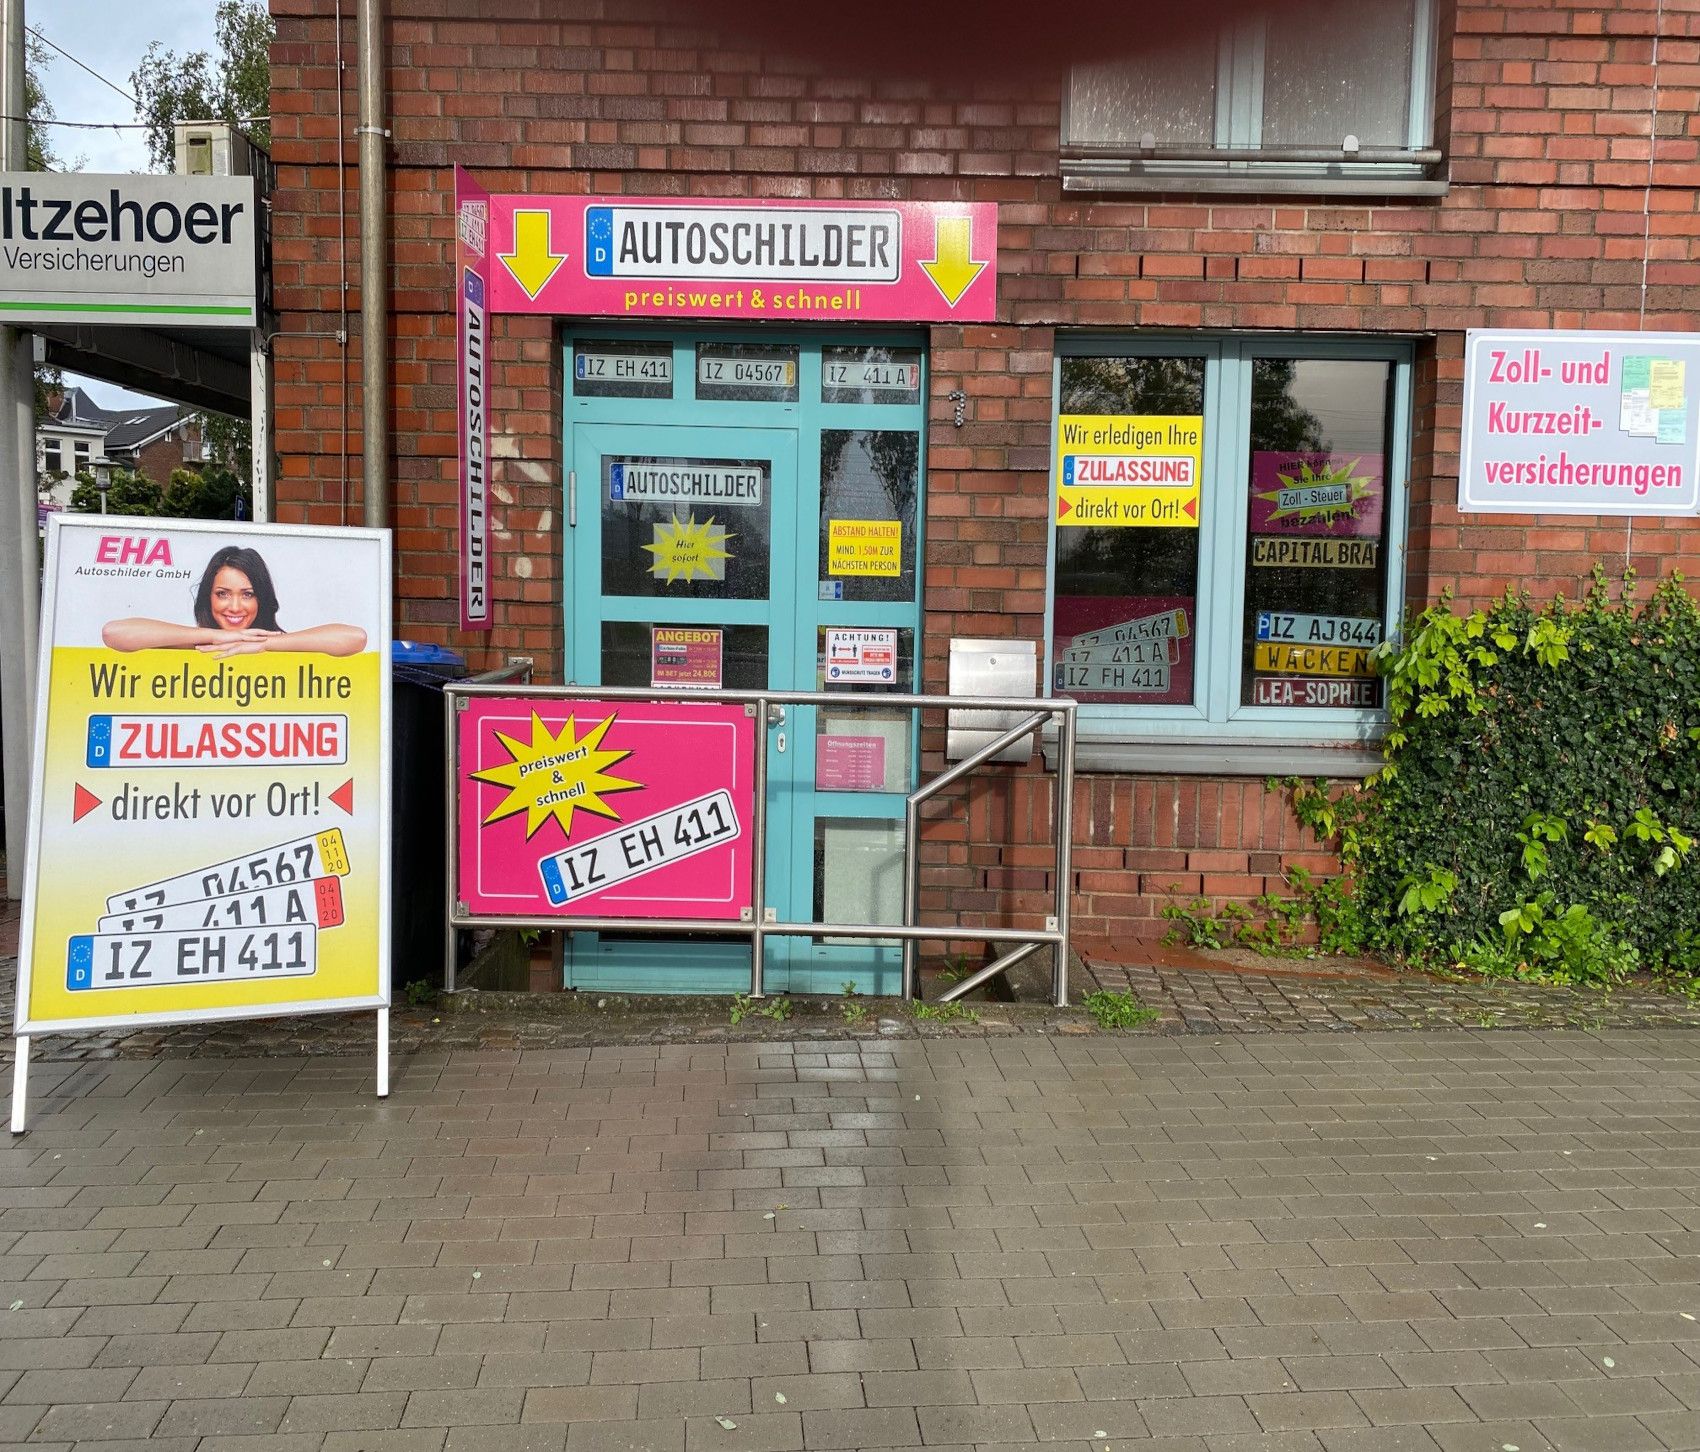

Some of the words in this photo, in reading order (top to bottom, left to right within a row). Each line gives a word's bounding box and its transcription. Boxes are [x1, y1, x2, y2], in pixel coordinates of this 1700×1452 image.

[2, 187, 244, 244] Itzehoer
[595, 247, 606, 263] D
[619, 221, 890, 268] AUTOSCHILDER
[4, 246, 185, 278] Versicherungen
[625, 287, 743, 311] preiswert
[750, 290, 765, 309] &
[773, 289, 861, 310] schnell
[587, 358, 605, 376] IZ
[616, 360, 635, 377] EH
[640, 360, 668, 378] 411
[705, 362, 723, 380] IZ
[735, 363, 783, 382] 04567
[830, 366, 847, 382] IZ
[896, 368, 906, 385] A
[1489, 350, 1551, 383] Zoll-
[1561, 351, 1610, 384] und
[1488, 402, 1602, 434] Kurzzeit-
[1063, 424, 1089, 444] Wir
[1093, 424, 1162, 450] erledigen
[1168, 424, 1197, 445] Ihre
[468, 306, 484, 608] AUTOSCHILDER
[1078, 460, 1189, 482] ZULASSUNG
[1484, 452, 1682, 496] versicherungen
[626, 471, 757, 498] AUTOSCHILDER
[1075, 497, 1119, 518] direkt
[1123, 503, 1146, 518] vor
[1151, 498, 1179, 519] Ort!
[1282, 492, 1302, 506] Zoll
[1310, 490, 1344, 503] Steuer
[833, 525, 866, 536] ABSTAND
[868, 526, 898, 537] HALTEN!
[96, 536, 173, 566] EHA
[675, 539, 695, 549] Hier
[880, 546, 894, 555] ZUR
[1254, 540, 1333, 564] CAPITAL
[1338, 542, 1374, 565] BRA
[671, 553, 699, 563] sofort
[832, 559, 868, 570] NÄCHSTEN
[870, 561, 897, 571] PERSON
[74, 566, 151, 578] Autoschilder
[155, 569, 192, 579] GmbH
[656, 630, 719, 643] ANGEBOT
[834, 633, 890, 641] ACHTUNG!
[1259, 617, 1269, 635] P
[1271, 616, 1295, 639] IZ
[1152, 642, 1163, 662] A
[1268, 646, 1368, 673] WACKEN
[90, 662, 141, 698] Wir
[151, 663, 286, 707] erledigen
[298, 664, 352, 699] Ihre
[1067, 667, 1089, 686] IZ
[1131, 668, 1164, 687] 411
[1259, 681, 1372, 705] LEA-SOPHIE
[95, 745, 104, 758] D
[119, 722, 338, 759] ZULASSUNG
[518, 745, 588, 778] preiswert
[552, 771, 564, 784] &
[111, 782, 201, 820] direkt
[211, 790, 256, 817] vor
[267, 781, 320, 816] Ort!
[536, 781, 586, 806] schnell
[321, 834, 337, 847] 04
[553, 883, 561, 895] D
[564, 847, 606, 891] IZ
[620, 825, 665, 869] EH
[673, 801, 731, 847] 411
[325, 848, 340, 858] 11
[328, 859, 343, 873] 20
[319, 885, 335, 895] 04
[285, 889, 307, 922] A
[322, 897, 335, 907] 11
[322, 910, 338, 921] 20
[76, 969, 85, 981] D
[105, 940, 152, 980] IZ
[177, 936, 226, 976] EH
[238, 931, 307, 971] 411
